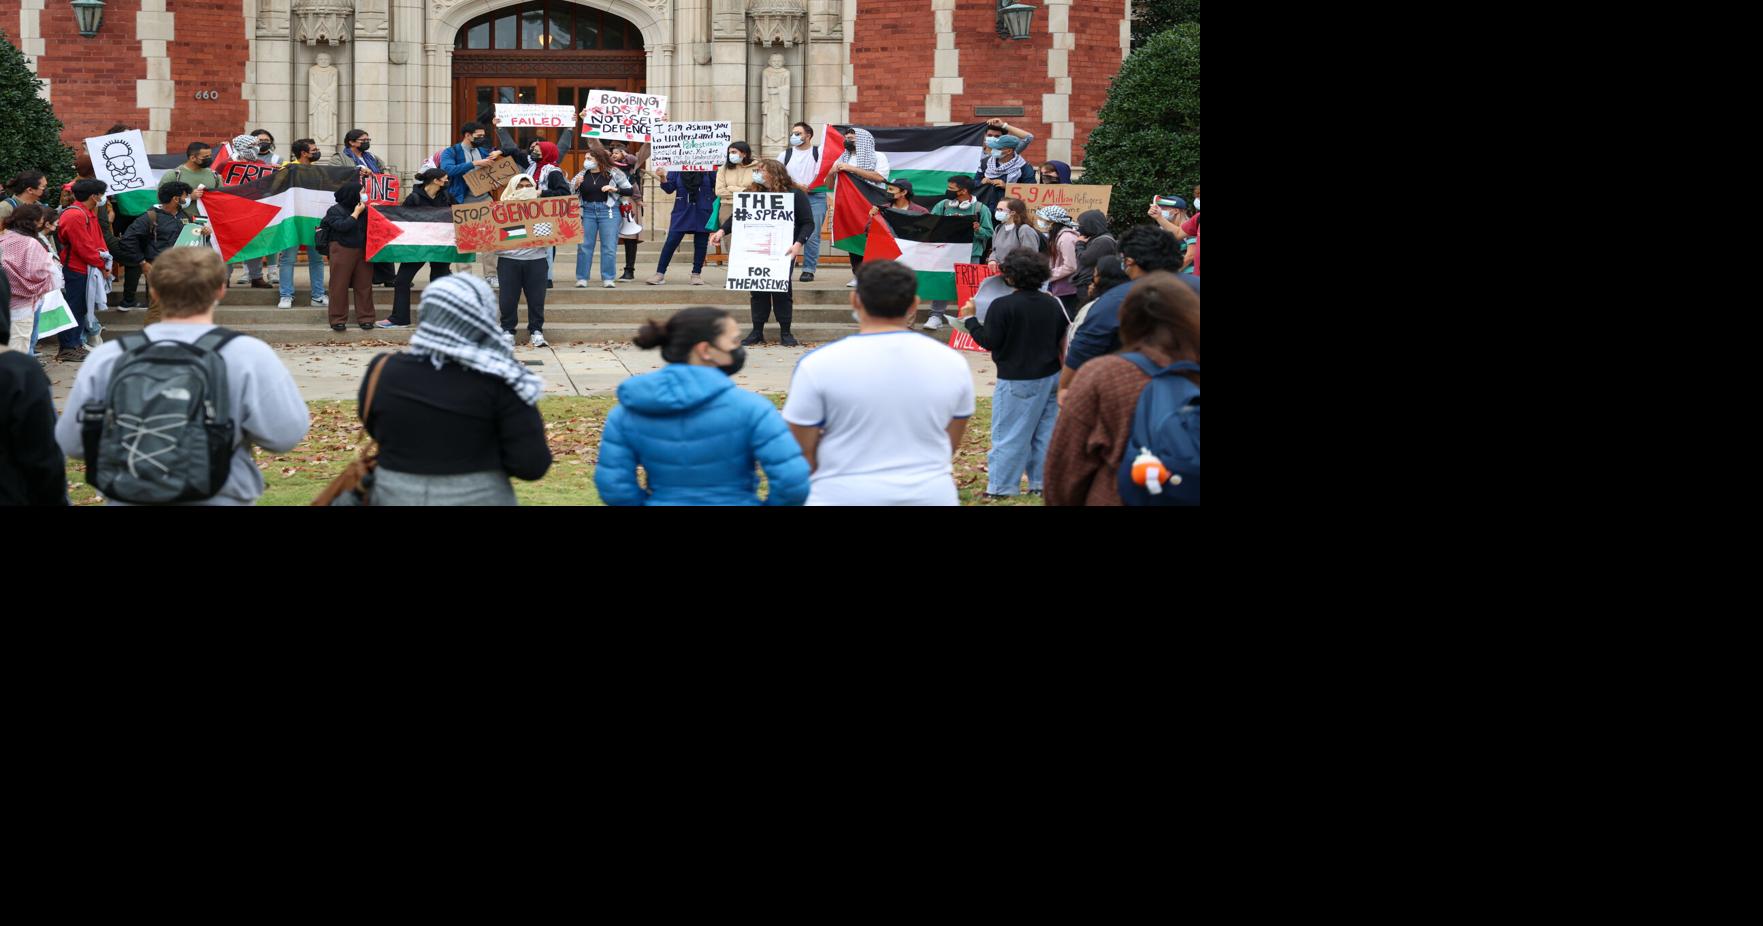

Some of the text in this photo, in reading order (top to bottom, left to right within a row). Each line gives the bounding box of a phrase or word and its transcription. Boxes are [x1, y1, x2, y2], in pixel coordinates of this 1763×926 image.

[195, 90, 219, 100] 660
[601, 94, 660, 108] BOMBING
[511, 117, 565, 127] FAILED.
[591, 114, 623, 124] NOT
[602, 124, 652, 135] DEFENCE
[654, 122, 729, 134] I am asking you
[225, 163, 280, 185] FRE
[738, 193, 784, 210] THE
[1041, 188, 1073, 203] Million
[453, 206, 490, 224] STOP
[492, 197, 579, 224] GENOCIDE
[754, 209, 794, 222] SPEAK
[748, 266, 771, 277] FOR
[955, 264, 979, 286] FROM
[727, 278, 789, 292] THEMSELVES
[953, 330, 975, 349] WILL
